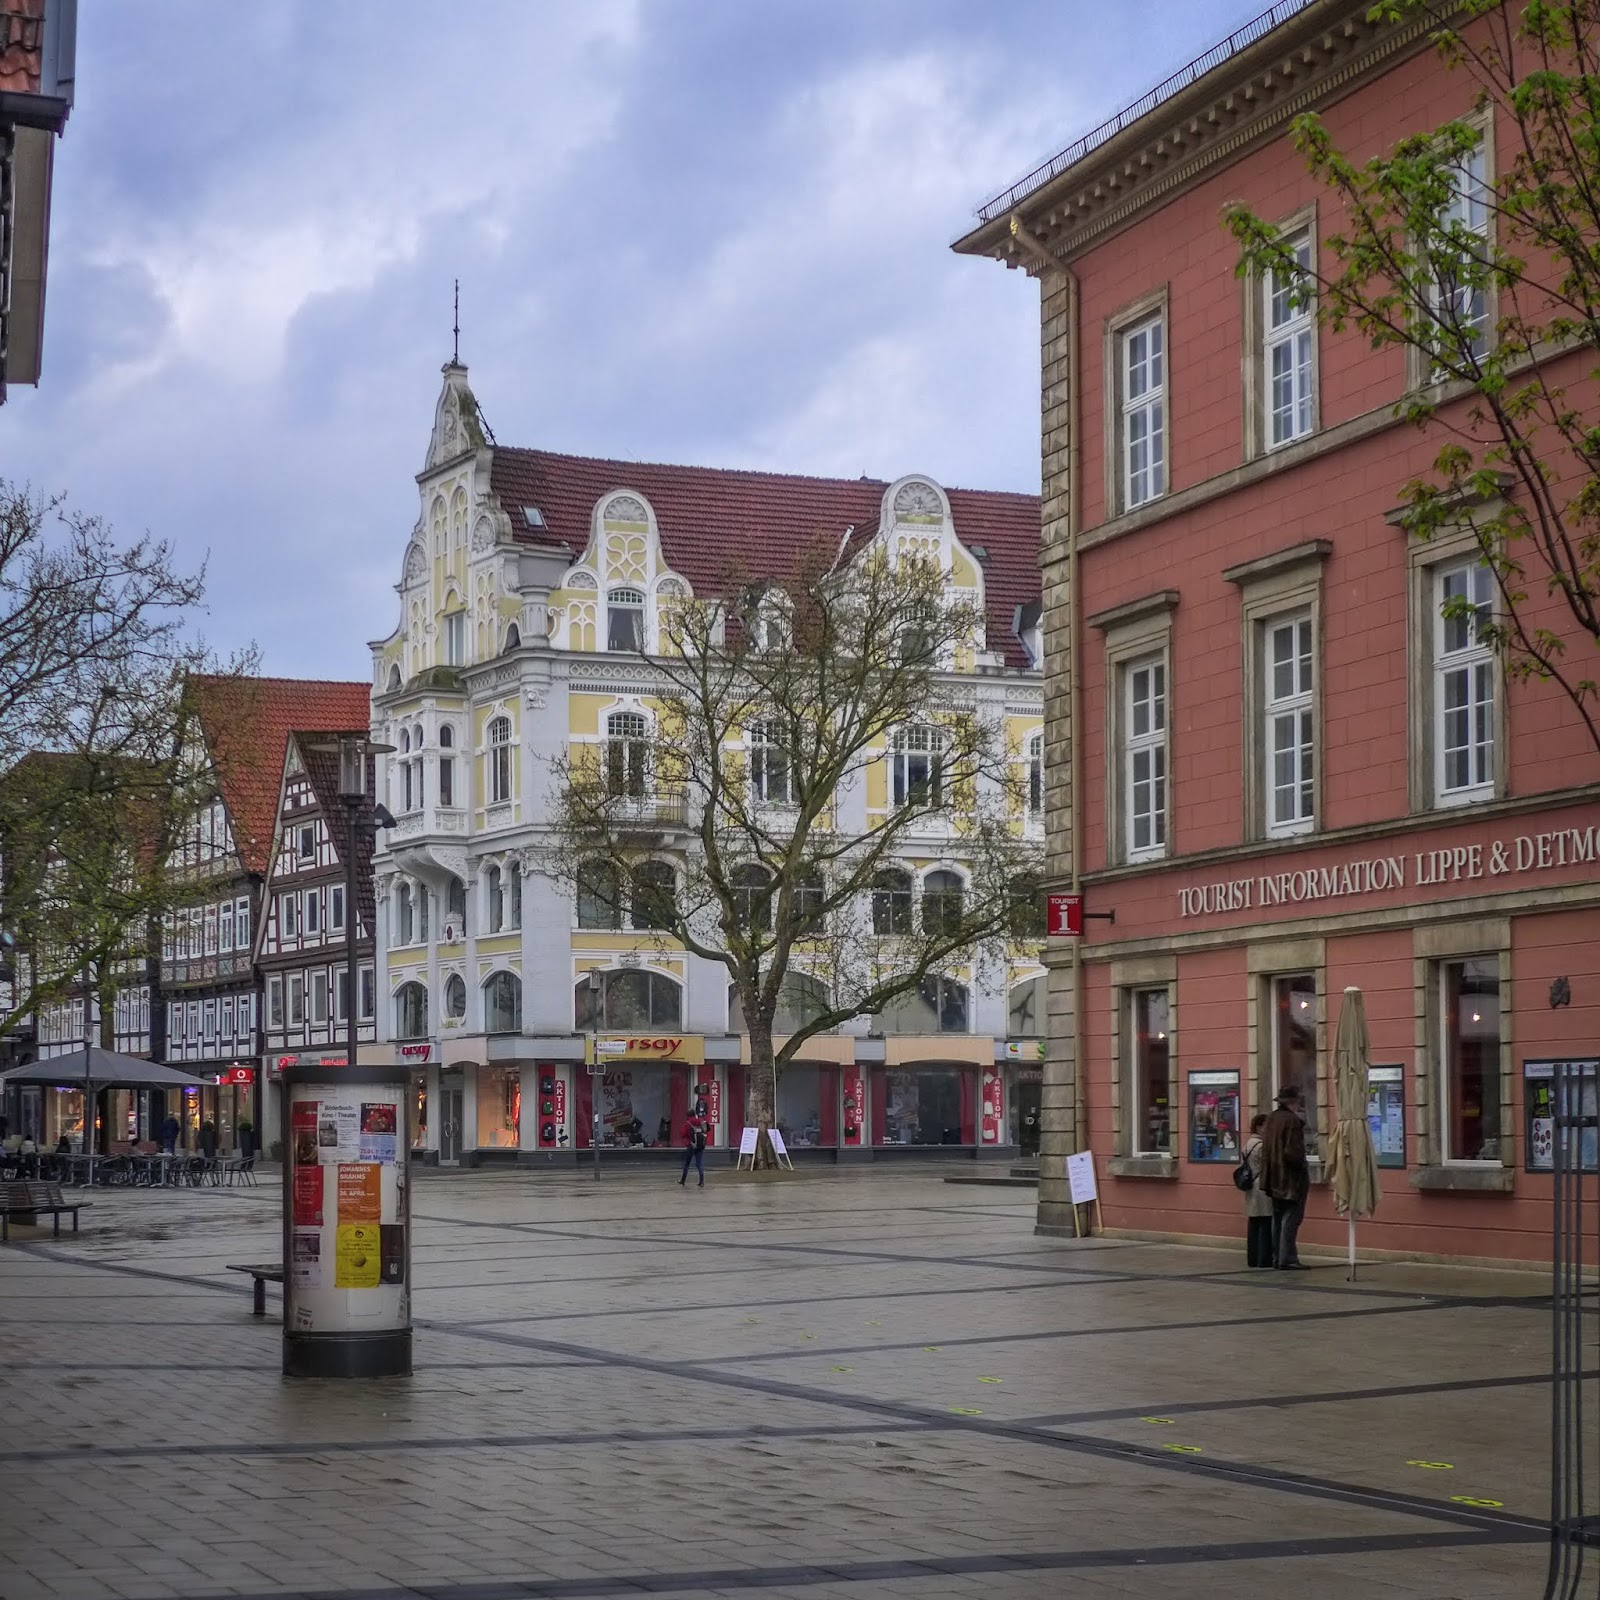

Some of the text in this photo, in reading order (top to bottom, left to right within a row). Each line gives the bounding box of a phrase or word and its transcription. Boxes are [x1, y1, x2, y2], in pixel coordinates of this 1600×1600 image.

[1178, 826, 1600, 917] TOURIST INFORMATION LIPPE & DETM
[401, 1044, 432, 1062] orsay
[613, 1038, 683, 1058] rsay
[555, 1081, 564, 1124] AKTION
[711, 1081, 719, 1123] AKTION
[855, 1081, 863, 1122] AKTION
